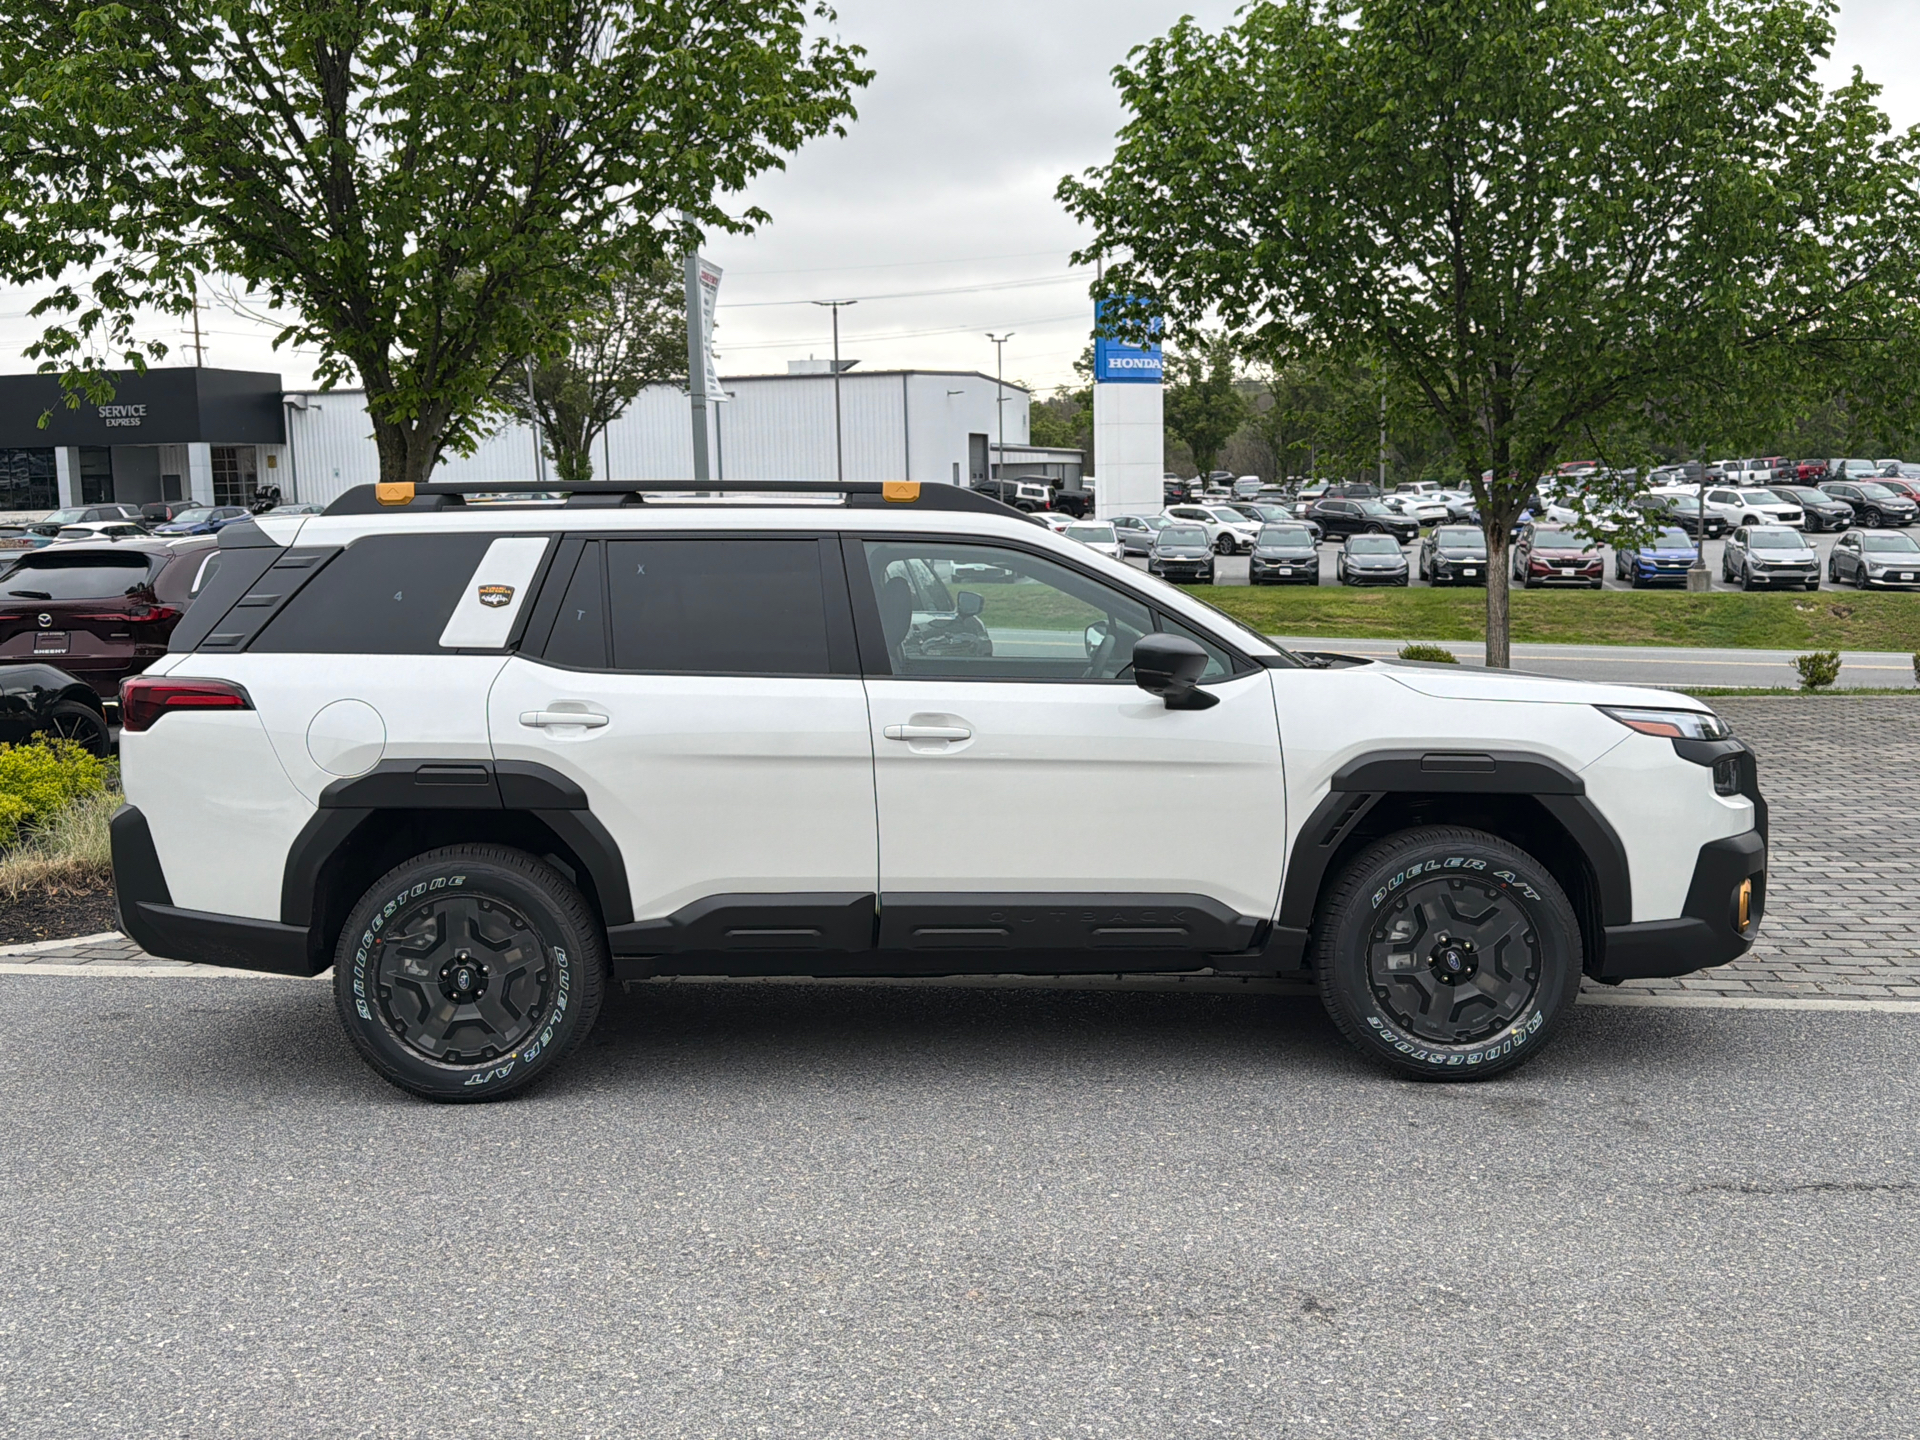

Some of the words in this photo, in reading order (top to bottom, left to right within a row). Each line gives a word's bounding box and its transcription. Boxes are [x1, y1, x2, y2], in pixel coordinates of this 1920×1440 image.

[1108, 358, 1162, 369] HONDA
[98, 404, 147, 418] SERVICE
[105, 417, 141, 427] EXPRESS
[1371, 857, 1487, 909] DUELER
[1493, 870, 1541, 901] A/T
[988, 911, 1187, 923] OUTBACK
[353, 875, 466, 1021] BRIDGESTONE
[523, 945, 570, 1064] DUELER
[1366, 1010, 1544, 1066] BRIDGESTONE
[463, 1061, 515, 1086] A/T
